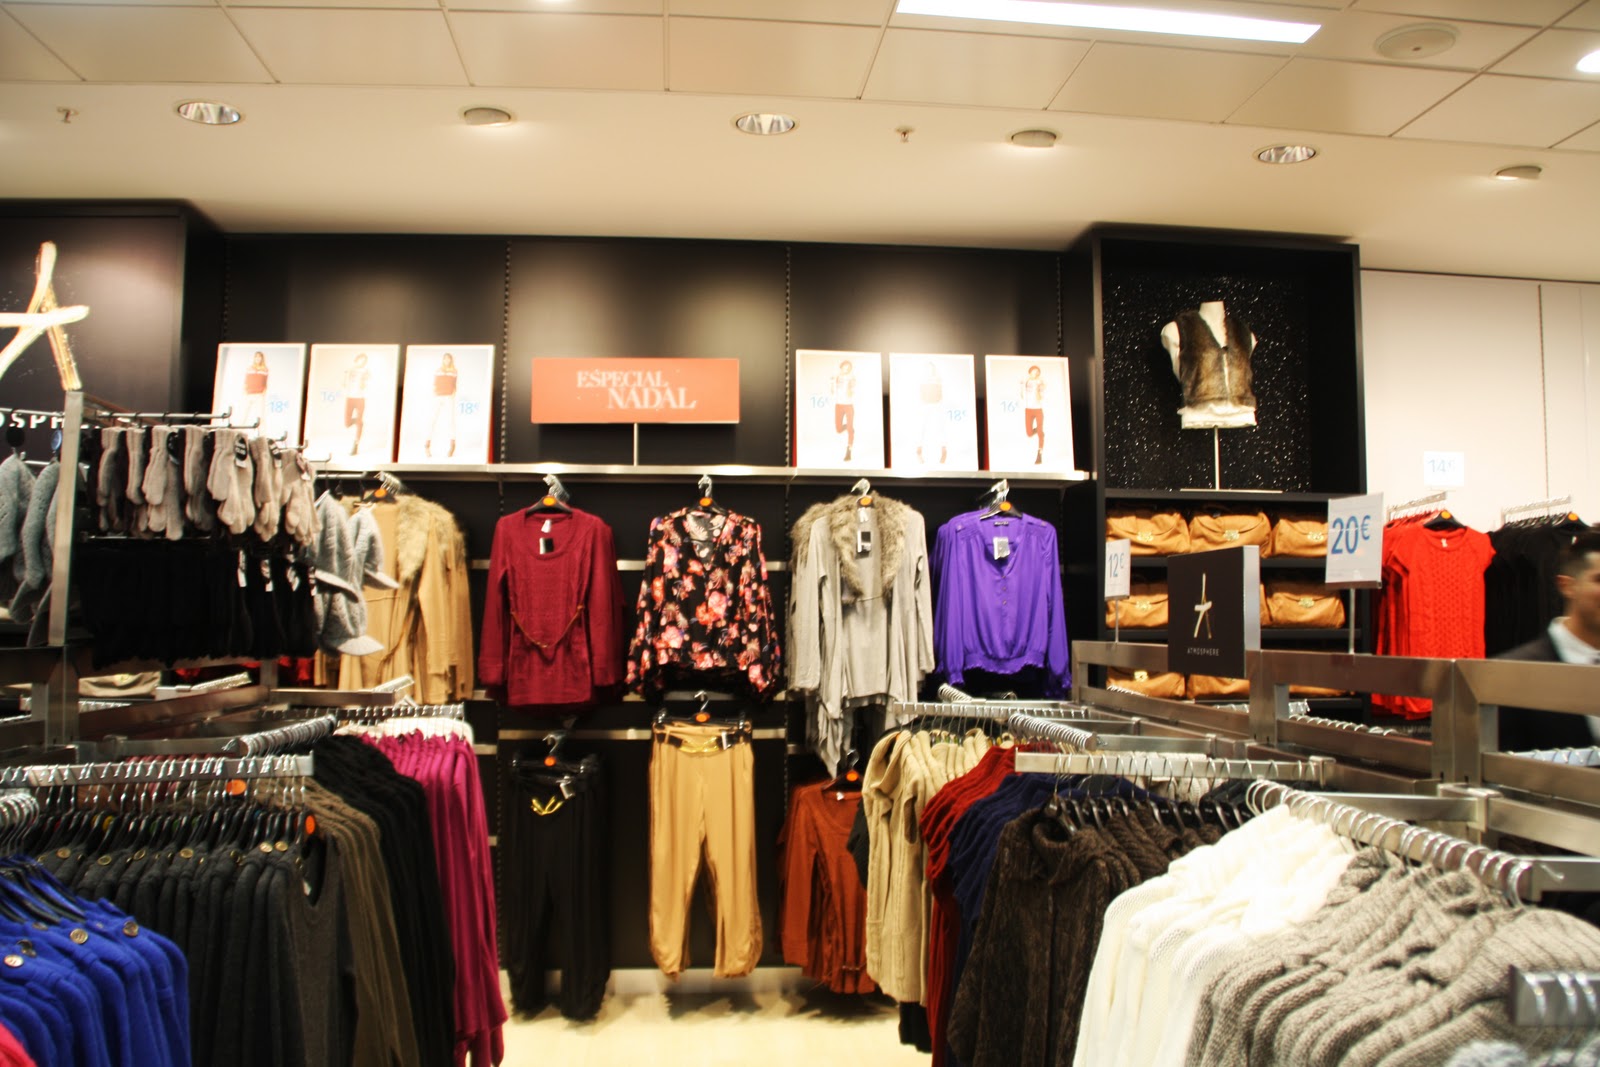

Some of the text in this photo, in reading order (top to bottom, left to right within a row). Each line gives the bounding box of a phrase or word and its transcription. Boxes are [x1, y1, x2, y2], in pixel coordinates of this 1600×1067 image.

[576, 369, 669, 388] ESPECIAL
[607, 386, 697, 409] NADAL
[1331, 514, 1371, 555] 20€
[1108, 552, 1125, 578] 12€
[1187, 647, 1220, 657] ATMOSPHERE
